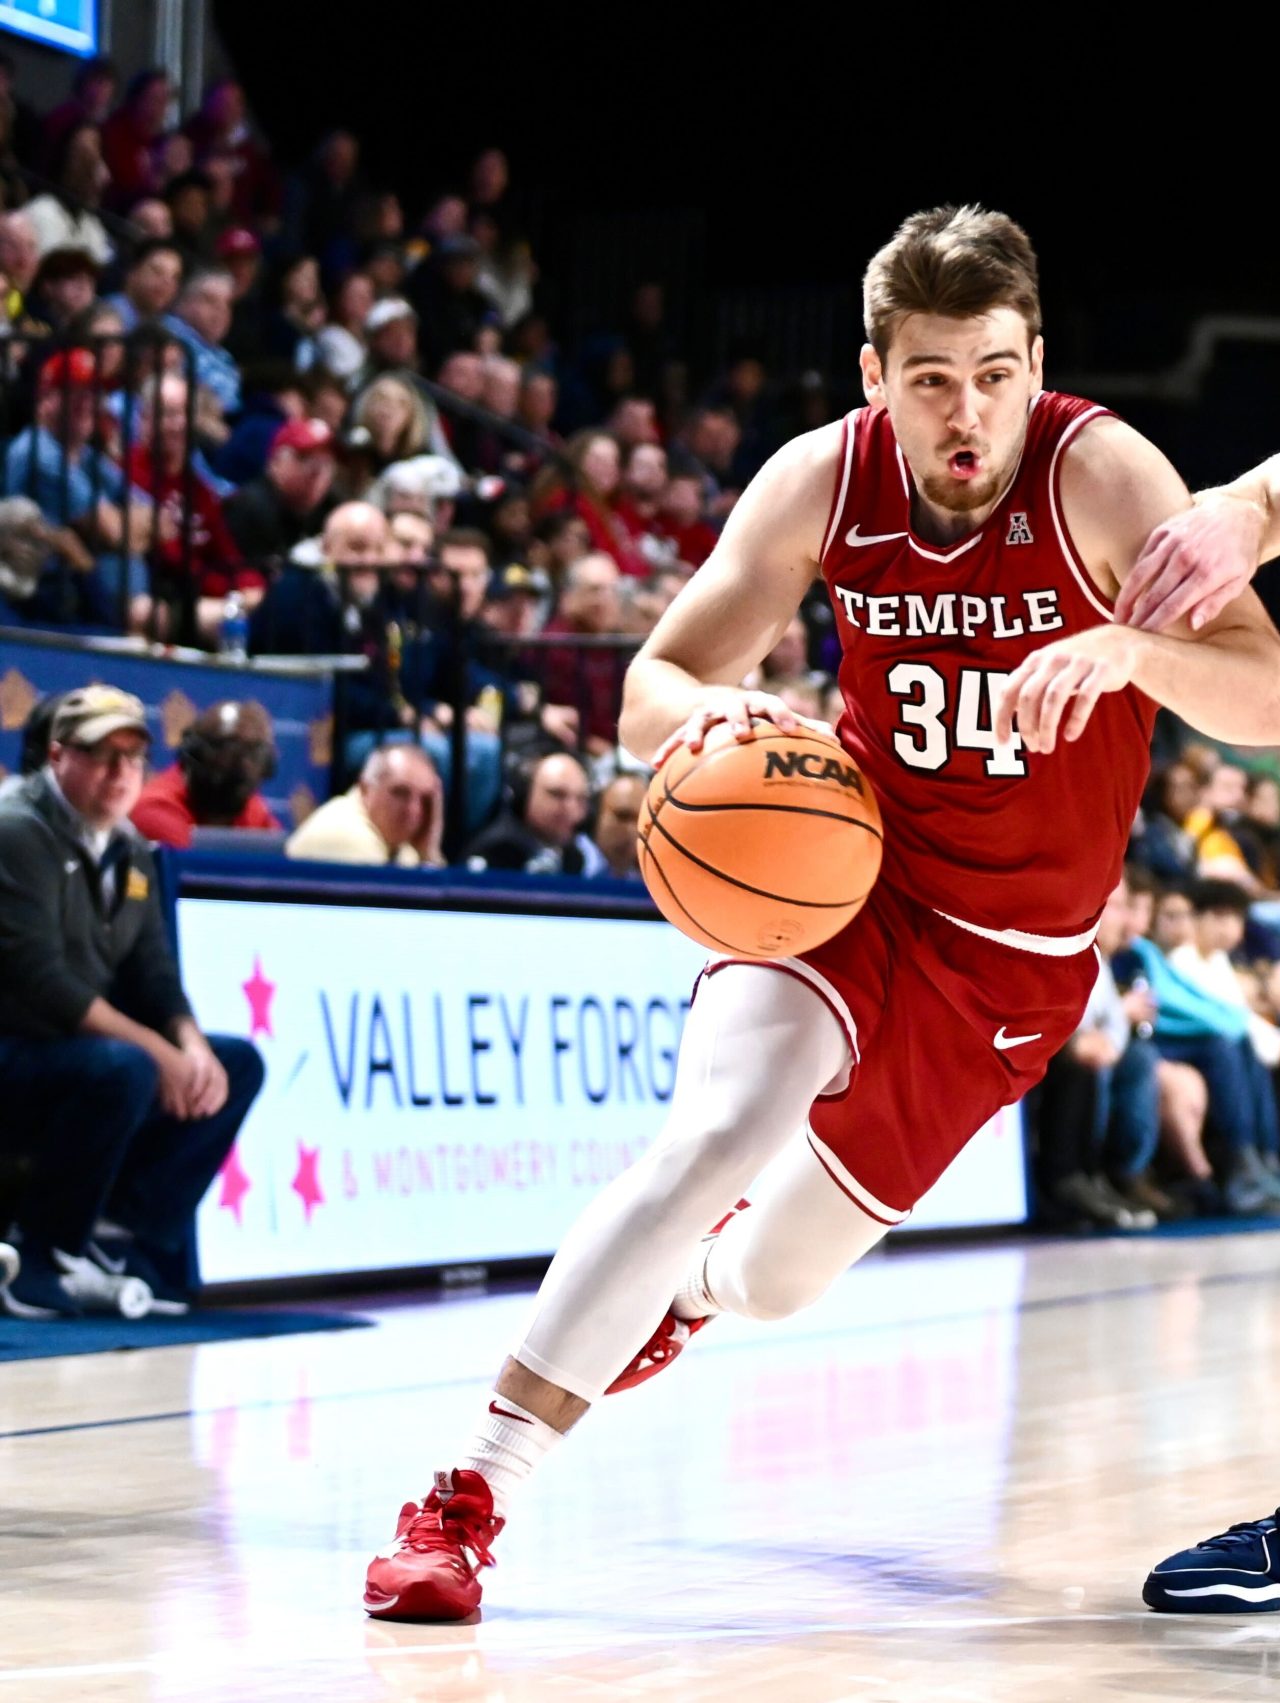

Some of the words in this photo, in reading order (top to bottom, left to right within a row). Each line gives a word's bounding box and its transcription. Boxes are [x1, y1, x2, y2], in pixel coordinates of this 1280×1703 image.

[834, 584, 1064, 639] TEMPLE
[887, 662, 1027, 777] 34
[763, 751, 865, 797] NCAA
[318, 990, 530, 1110] VALLEY
[370, 1139, 559, 1197] MONTGOMERY
